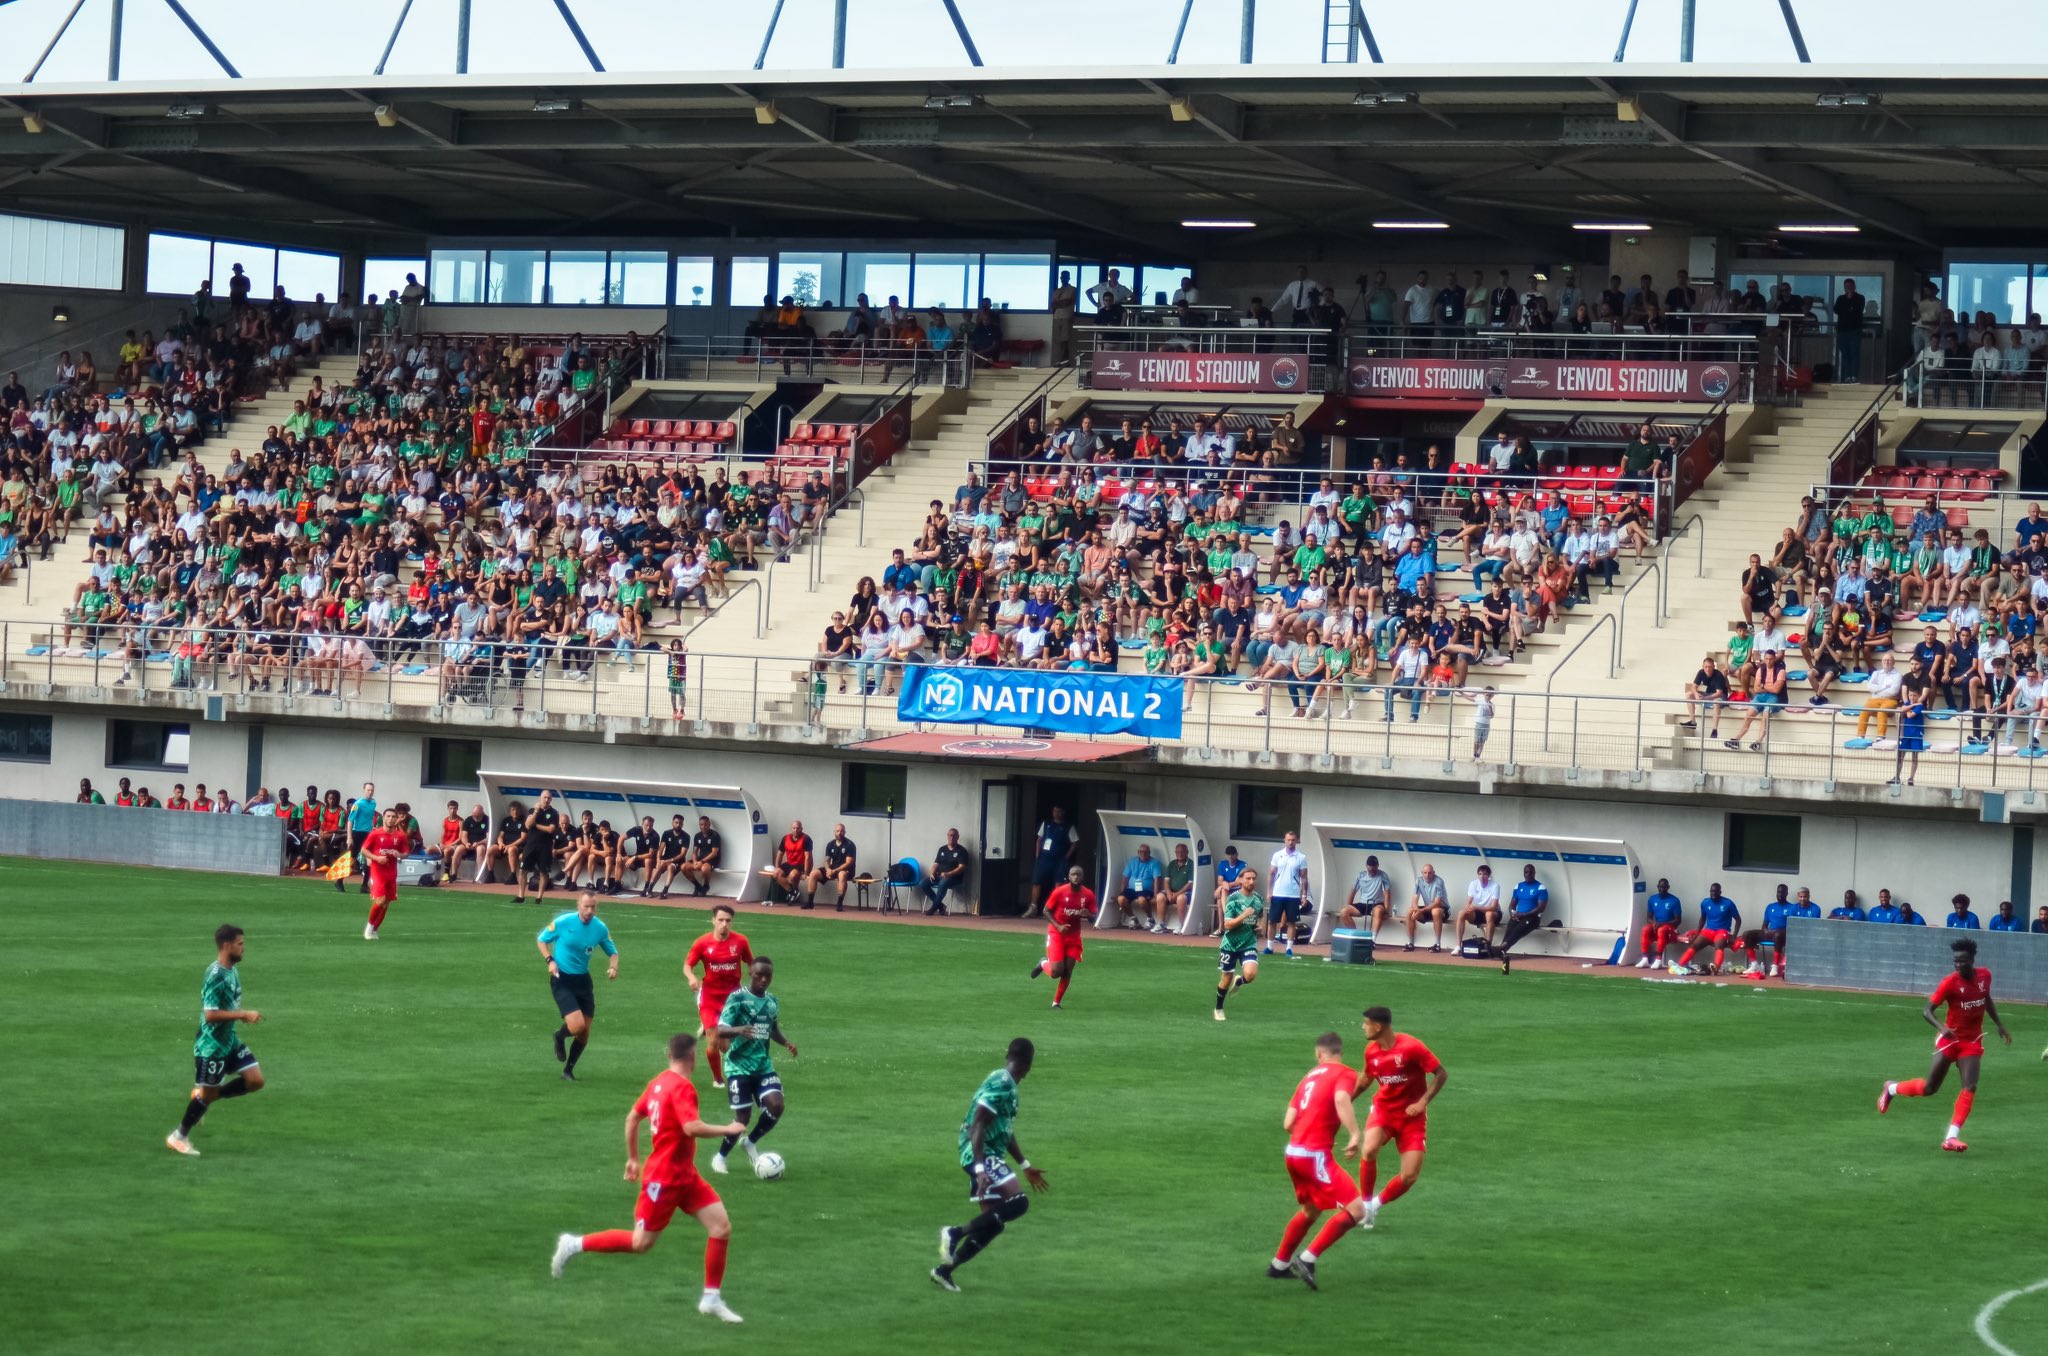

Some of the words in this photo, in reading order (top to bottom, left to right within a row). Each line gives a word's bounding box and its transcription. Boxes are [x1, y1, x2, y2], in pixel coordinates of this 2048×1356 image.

[1139, 358, 1192, 383] L'ENVOL
[1196, 360, 1260, 384] STADIUM
[1372, 366, 1421, 388] L'ENVOL
[1424, 367, 1485, 390] STADIUM
[1557, 366, 1615, 392] L'ENVOL
[1618, 368, 1688, 393] STADIUM
[925, 683, 956, 706] N2
[972, 684, 1135, 719] NATIONAL
[1143, 692, 1161, 720] 2
[1220, 953, 1231, 964] 22
[208, 1061, 225, 1075] 37
[1300, 1081, 1315, 1110] 3
